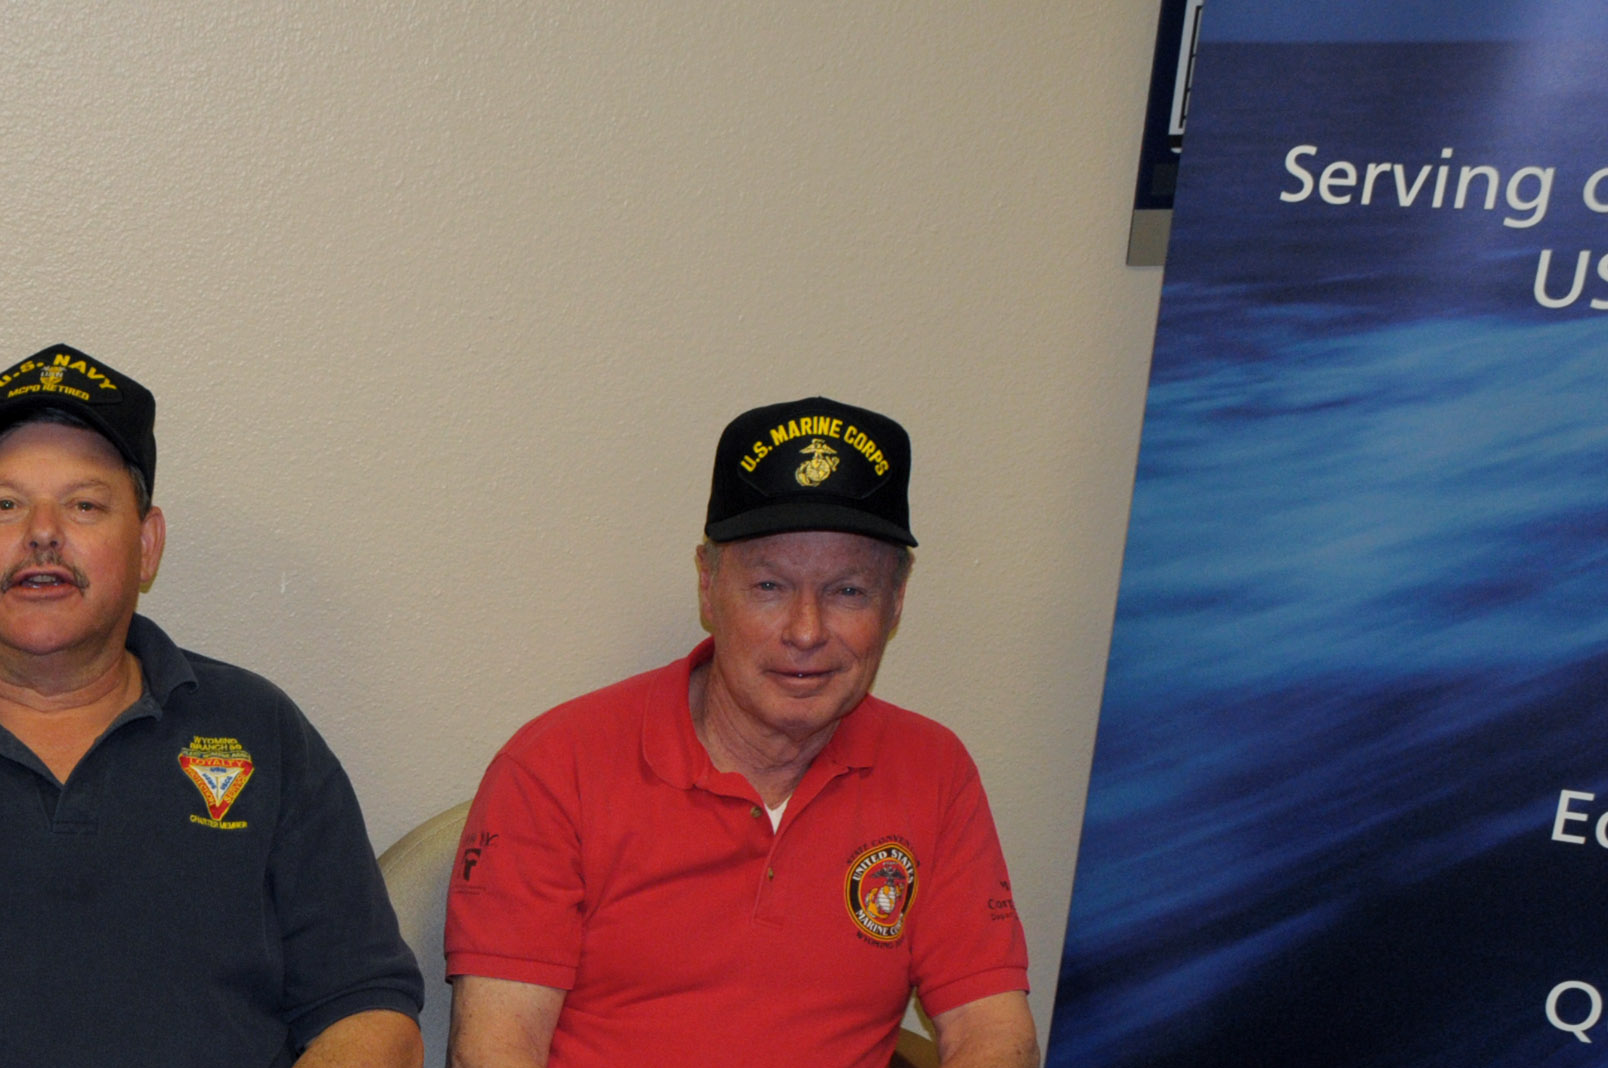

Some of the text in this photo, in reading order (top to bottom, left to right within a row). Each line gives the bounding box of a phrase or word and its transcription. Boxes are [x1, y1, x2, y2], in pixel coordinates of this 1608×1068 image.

[1280, 144, 1555, 228] Serving
[53, 354, 117, 390] NAVY
[8, 383, 90, 400] MCPO RETIRED
[740, 416, 890, 476] U.S. MARINE CORPS
[852, 848, 915, 884] UNITED STATES
[855, 910, 889, 937] MARINE
